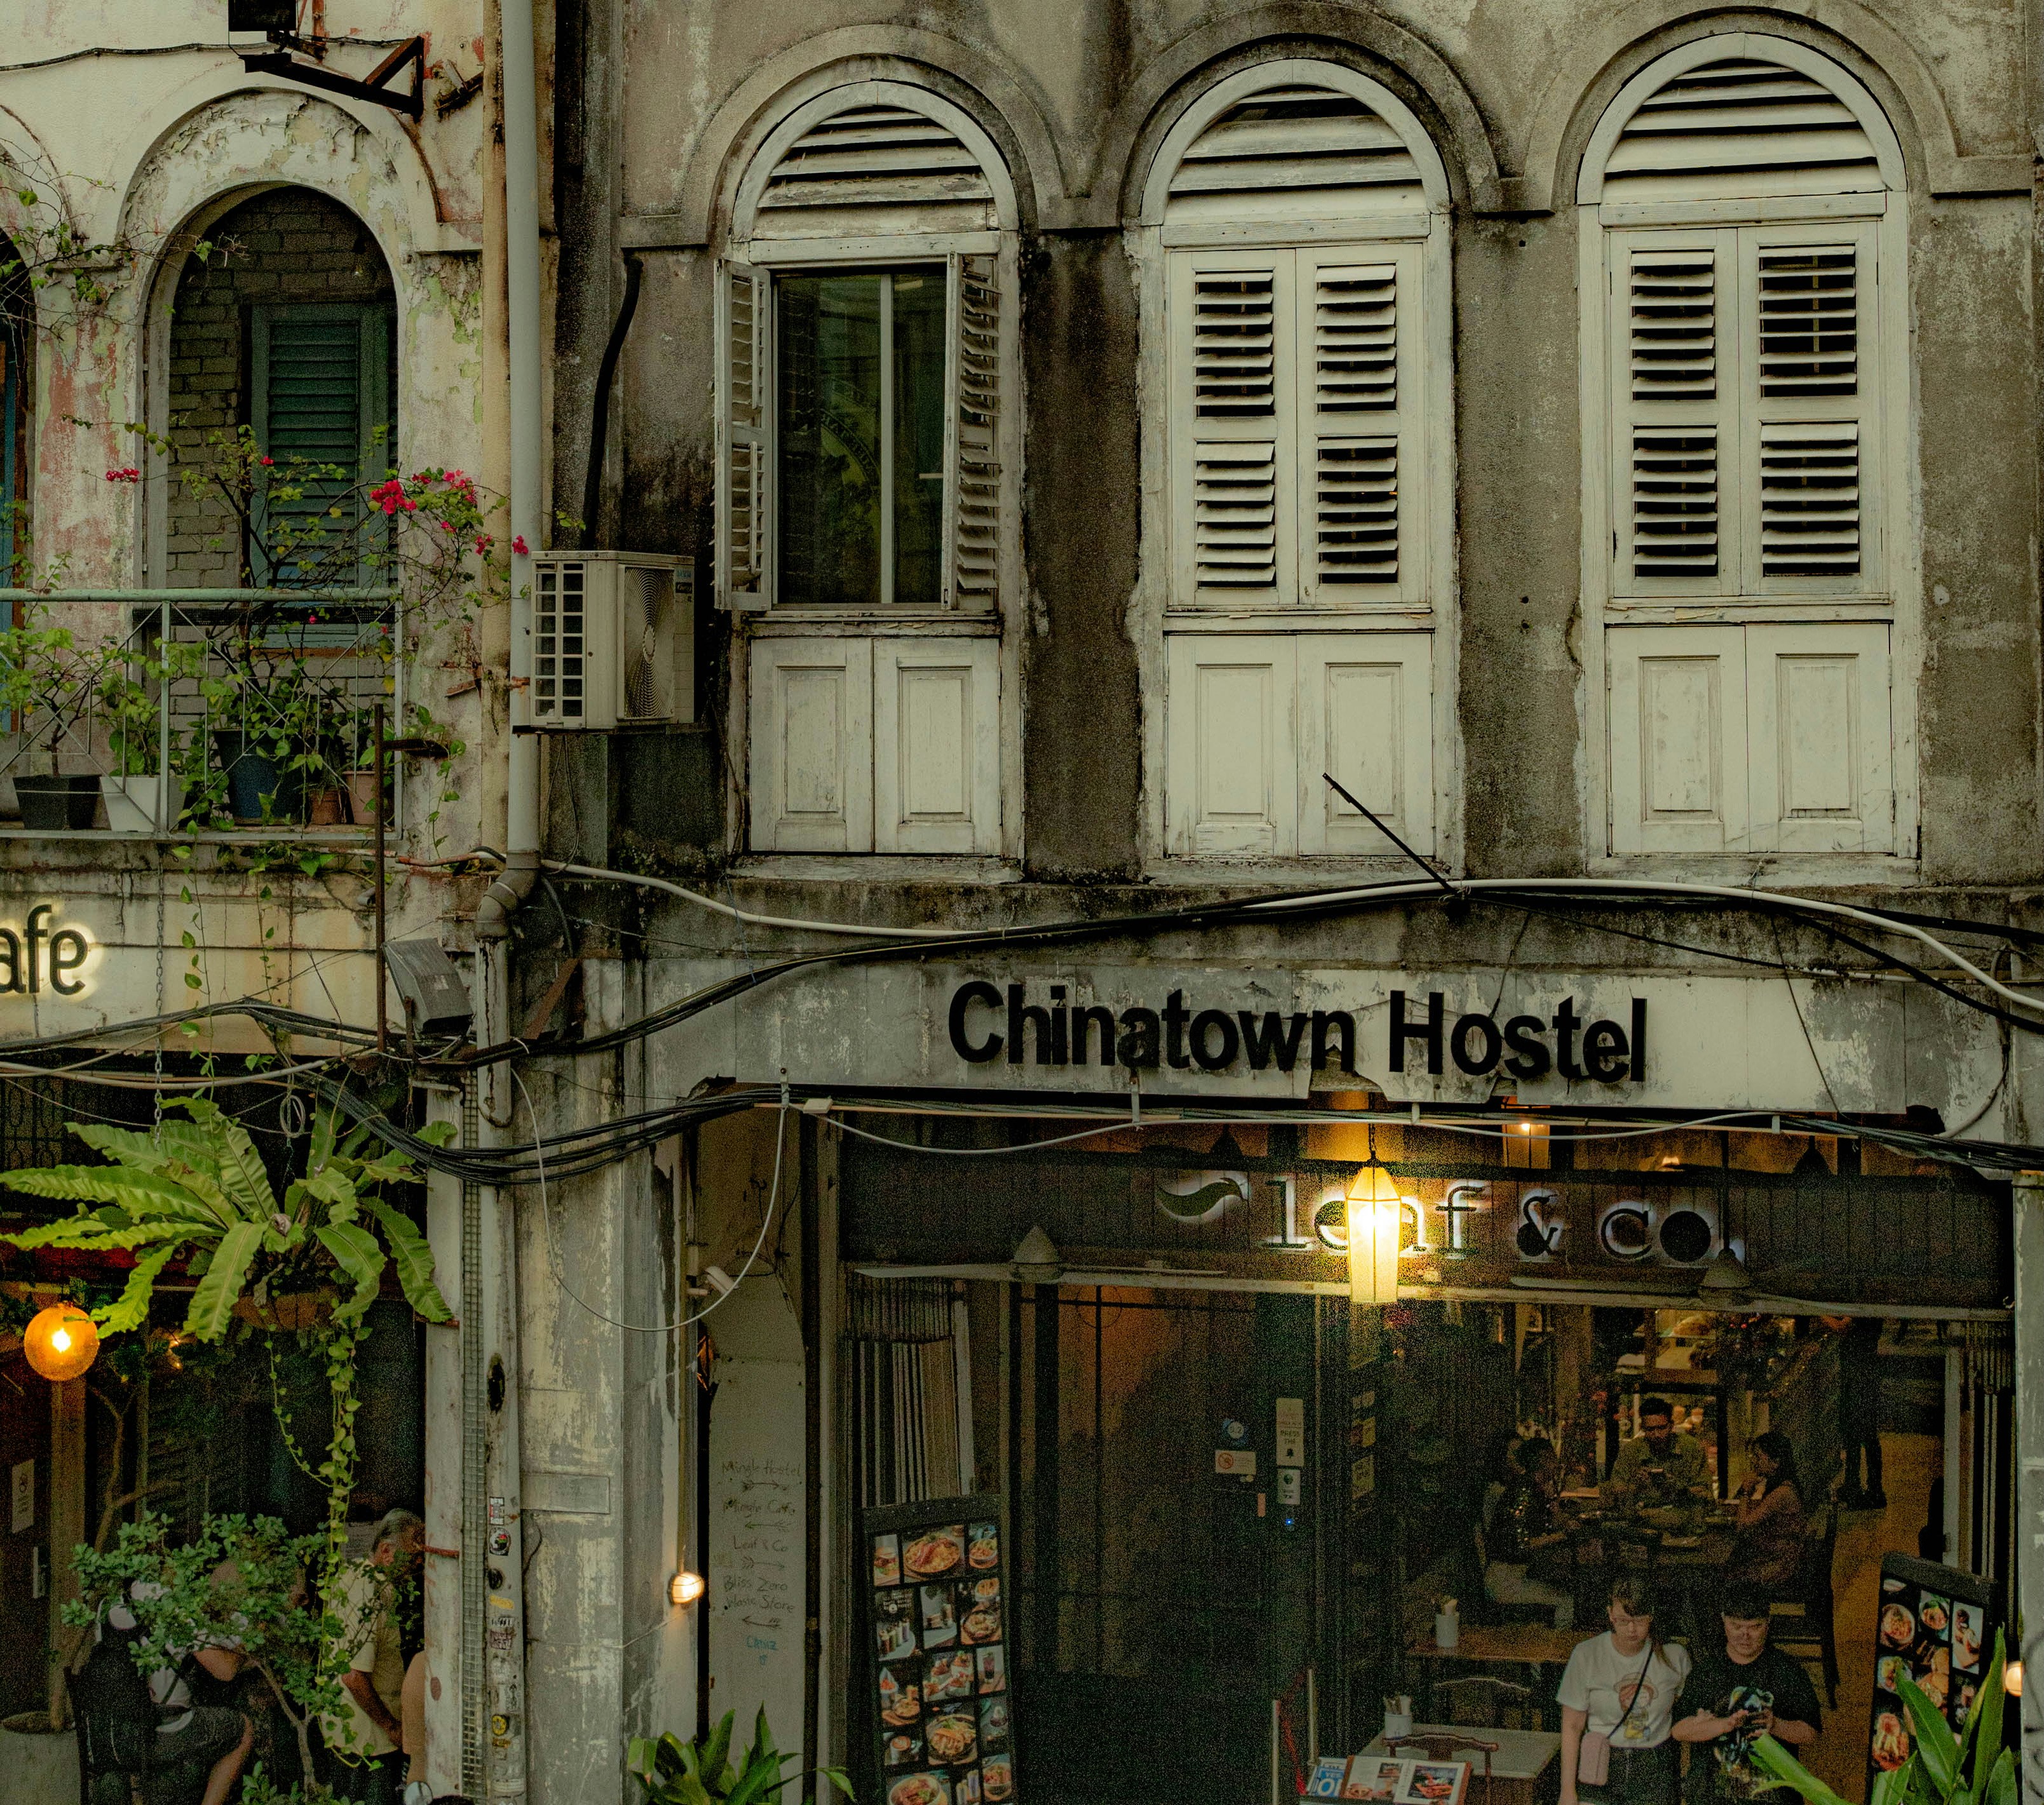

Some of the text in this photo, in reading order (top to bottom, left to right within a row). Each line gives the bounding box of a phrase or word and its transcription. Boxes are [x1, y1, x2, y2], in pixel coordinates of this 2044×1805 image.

[948, 980, 1648, 1084] Chinatown Hostel
[1516, 1194, 1559, 1257] &
[759, 1594, 795, 1613] Store
